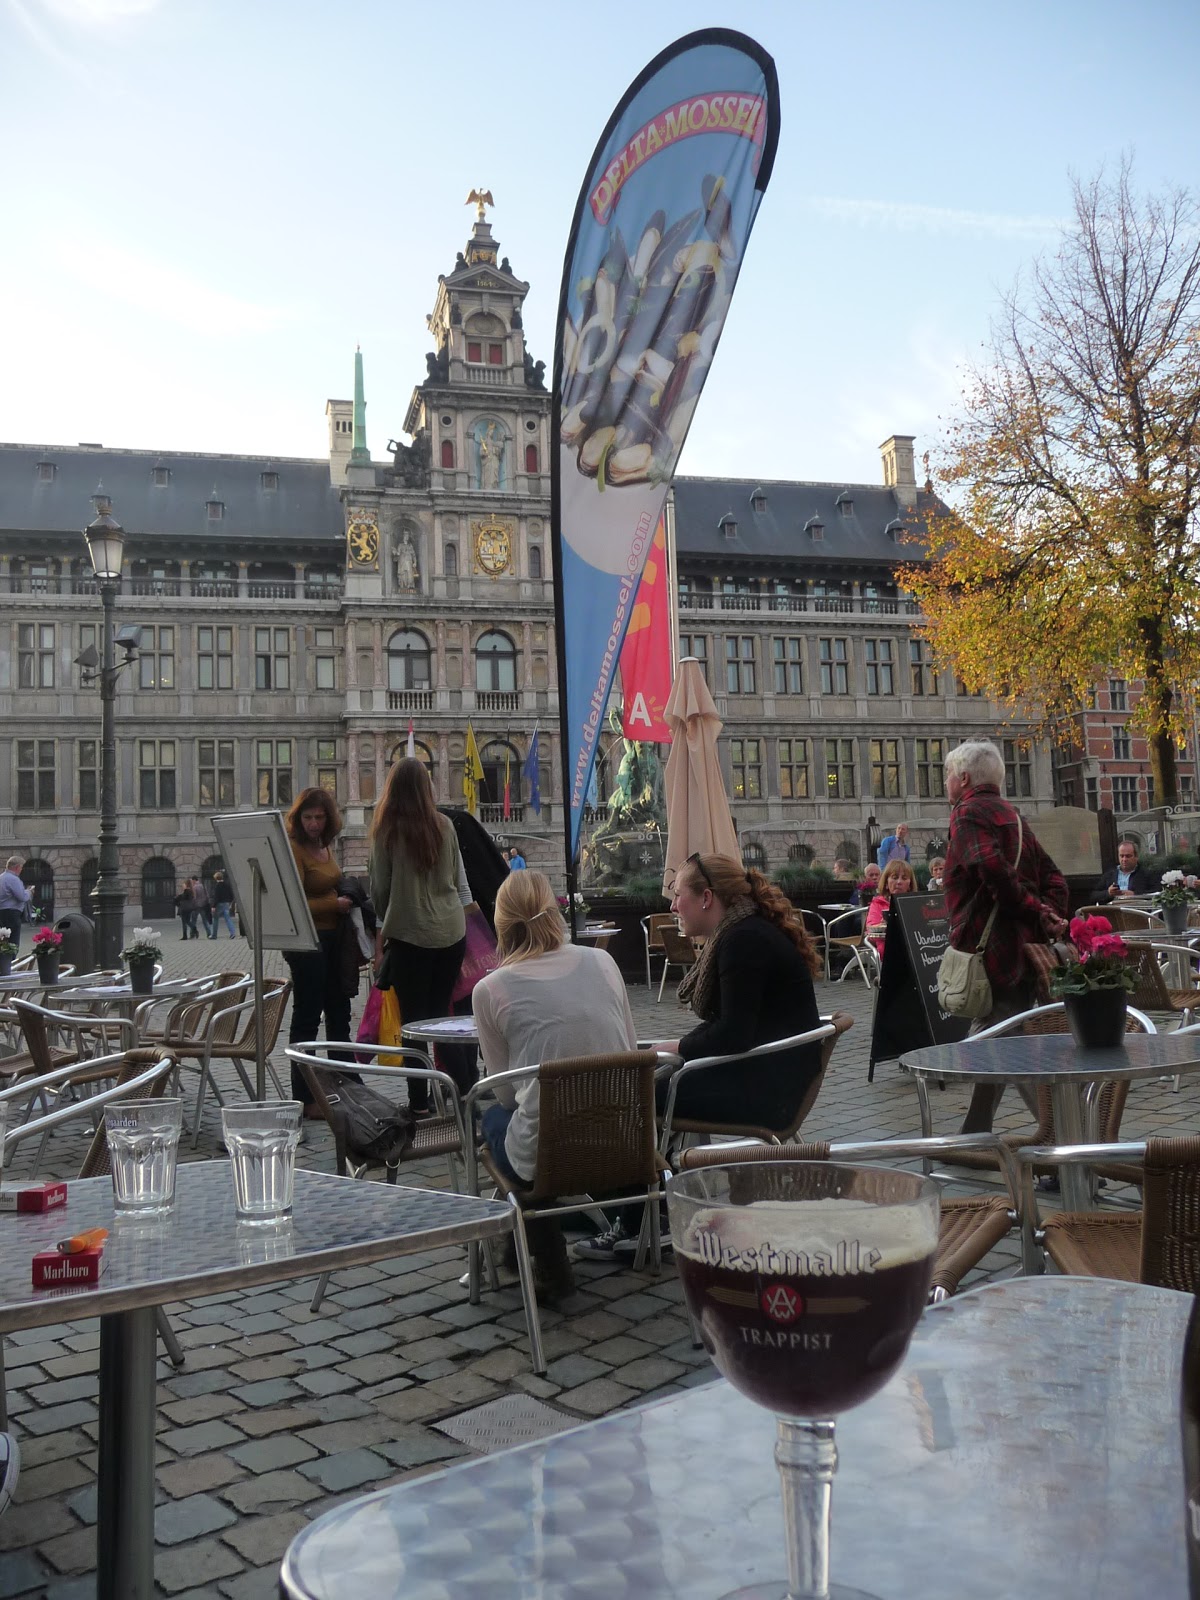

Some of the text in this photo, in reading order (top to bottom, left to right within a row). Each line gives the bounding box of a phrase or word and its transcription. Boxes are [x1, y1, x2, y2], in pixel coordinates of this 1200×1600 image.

[571, 510, 652, 809] www.deltamossel.com
[628, 692, 652, 727] A
[914, 929, 948, 946] Vandaa
[695, 1229, 882, 1277] Westmalle
[43, 1260, 89, 1280] Marlboro
[740, 1327, 832, 1350] TRAPPIST
